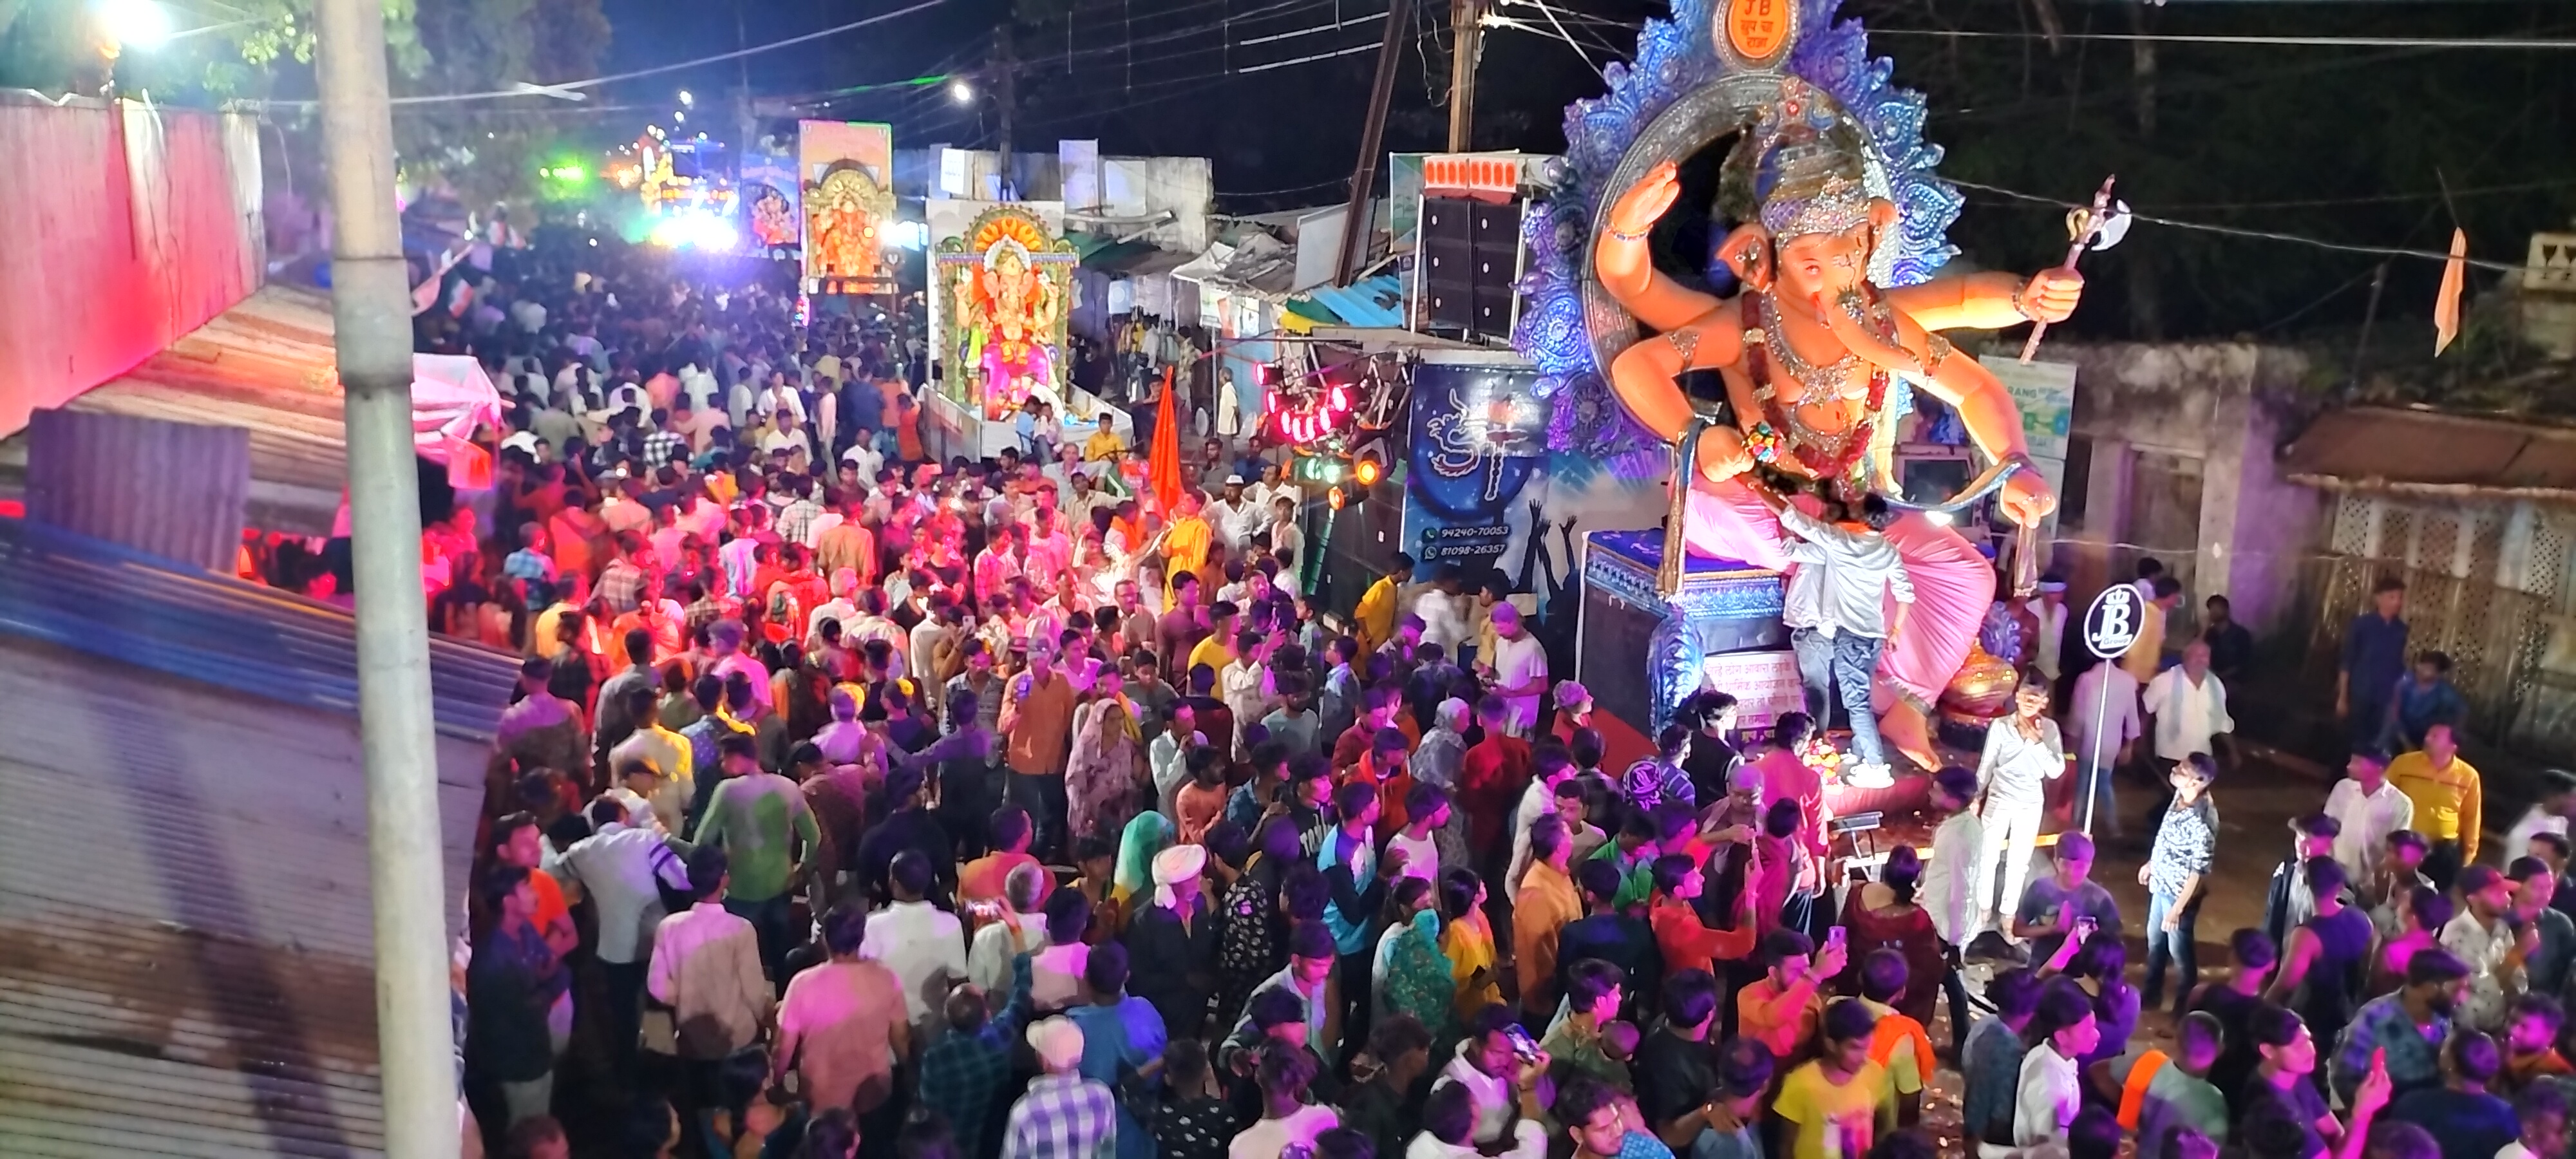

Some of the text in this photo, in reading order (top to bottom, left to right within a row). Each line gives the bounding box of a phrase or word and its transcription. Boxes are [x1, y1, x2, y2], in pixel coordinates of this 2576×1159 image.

[1745, 0, 1770, 15] J B
[1441, 526, 1508, 538] 94240-70053
[1441, 544, 1505, 556] 81098-26357
[2092, 604, 2131, 641] JB
